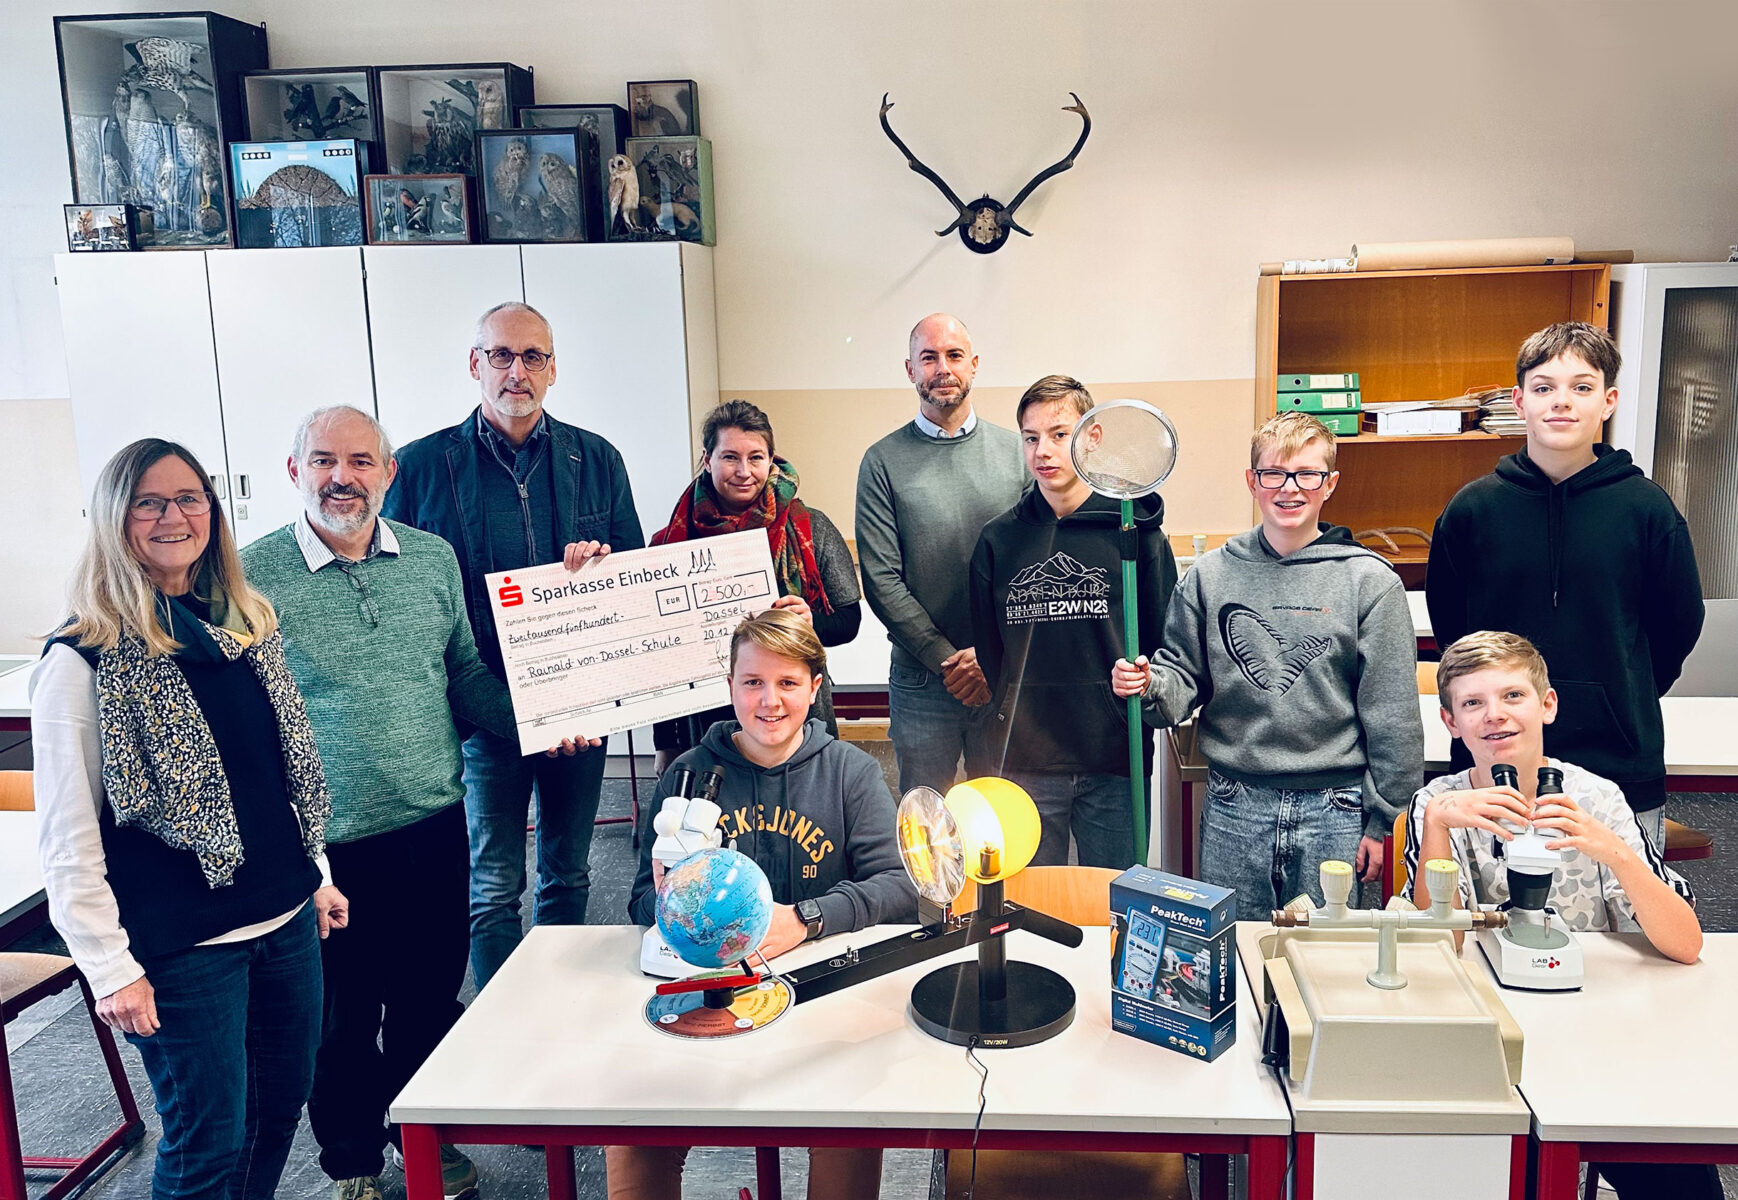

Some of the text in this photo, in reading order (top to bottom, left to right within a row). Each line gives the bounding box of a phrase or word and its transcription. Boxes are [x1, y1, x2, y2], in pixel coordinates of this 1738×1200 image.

[532, 563, 680, 605] Sparkasse Einbeck
[577, 604, 597, 613] Scheck
[666, 596, 680, 605] EUR
[703, 602, 746, 622] Dassel
[802, 864, 818, 879] 90
[1137, 922, 1157, 942] 231
